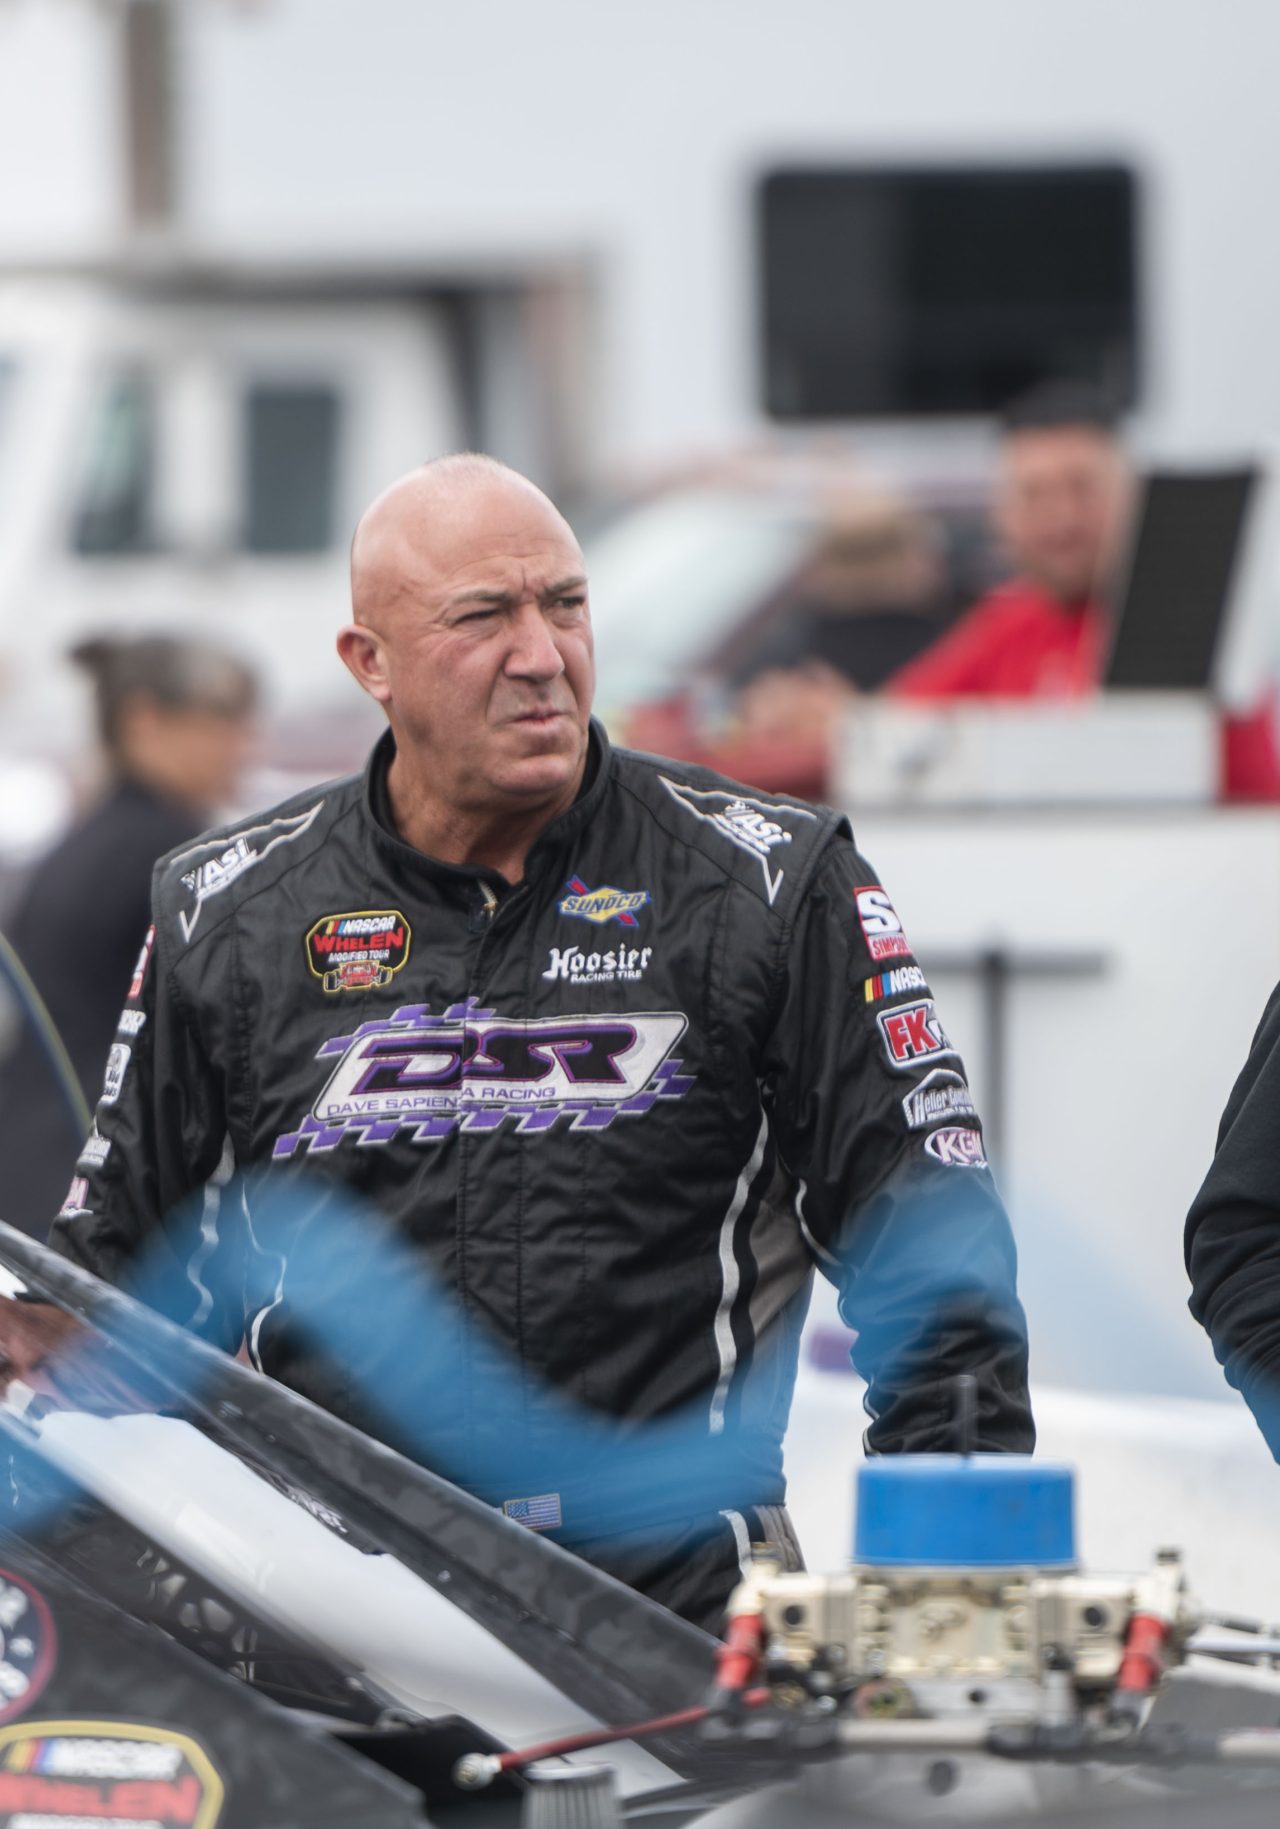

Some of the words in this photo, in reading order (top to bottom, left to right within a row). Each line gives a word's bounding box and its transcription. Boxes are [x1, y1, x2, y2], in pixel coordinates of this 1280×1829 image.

[565, 893, 644, 913] SUNOCO
[342, 915, 396, 935] NASCAR
[313, 927, 404, 954] WHELEN
[327, 950, 368, 964] MODIFIED
[368, 948, 390, 961] TOUR
[542, 942, 652, 979] Hoosier
[570, 971, 615, 984] RACING
[616, 969, 642, 979] TIRE
[350, 1022, 637, 1095] DSR
[326, 1099, 379, 1117] DAVE
[384, 1087, 475, 1110] SAPIENA
[481, 1086, 556, 1100] RACING
